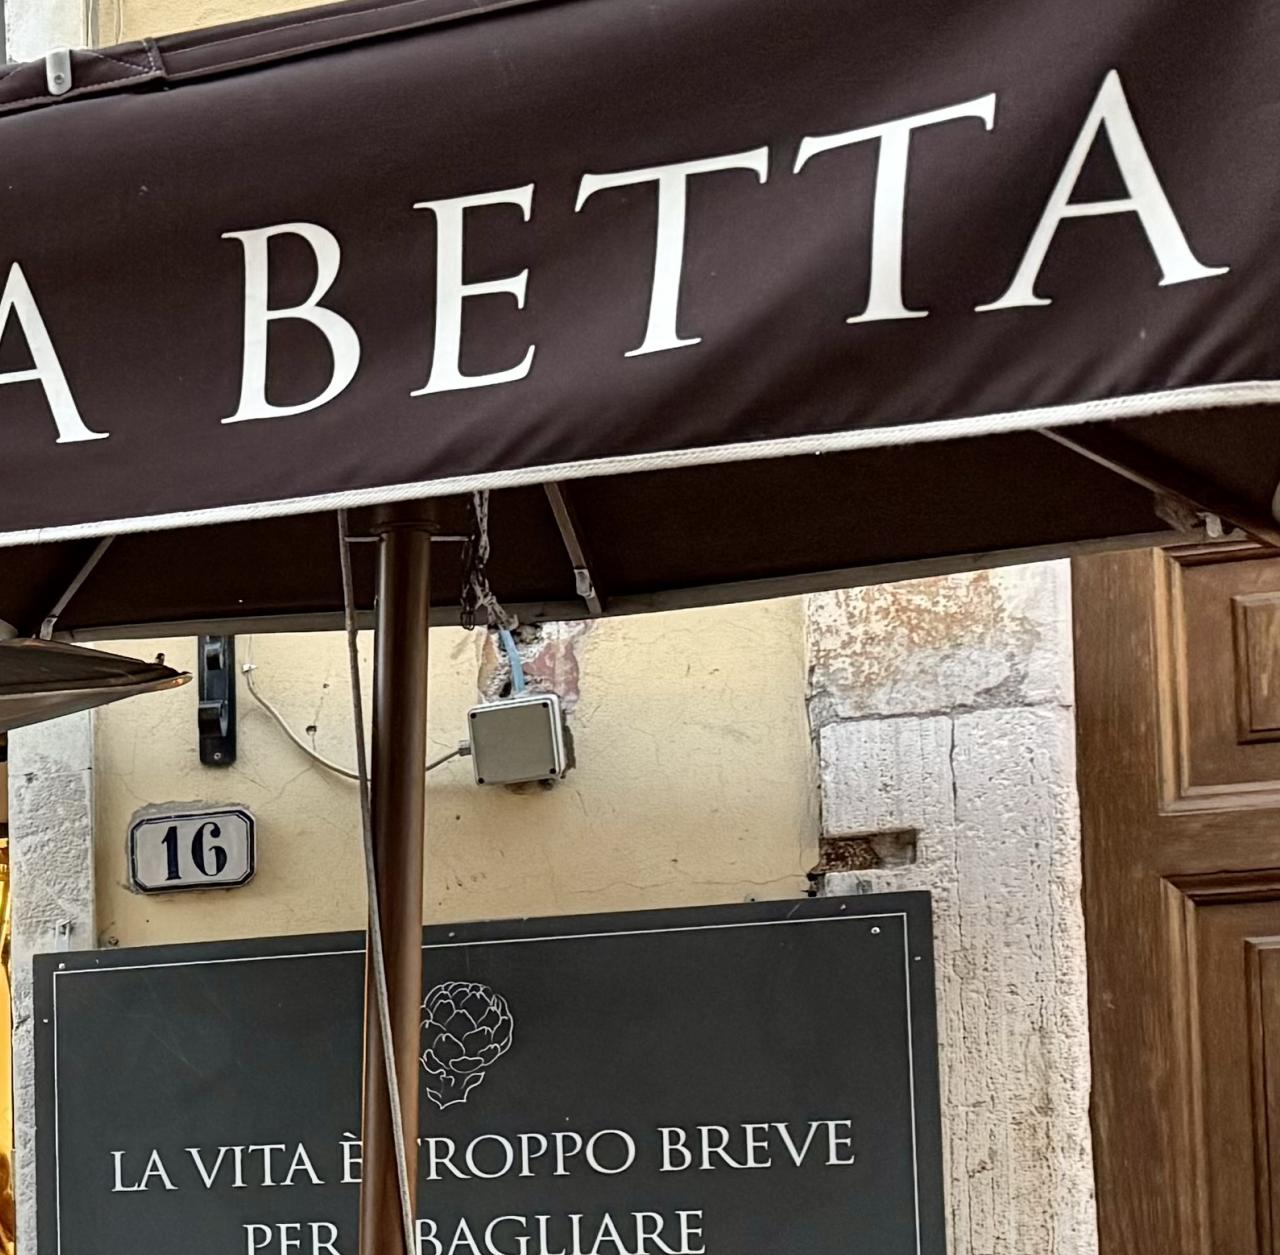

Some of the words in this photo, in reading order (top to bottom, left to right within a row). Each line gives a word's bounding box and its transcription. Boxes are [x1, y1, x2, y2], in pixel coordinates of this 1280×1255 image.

[219, 68, 1231, 428] BETTA
[160, 820, 228, 882] 16
[109, 1149, 179, 1193] LA
[184, 1141, 326, 1190] VITA
[416, 1129, 637, 1181] ROPPO
[656, 1119, 856, 1172] BREVE
